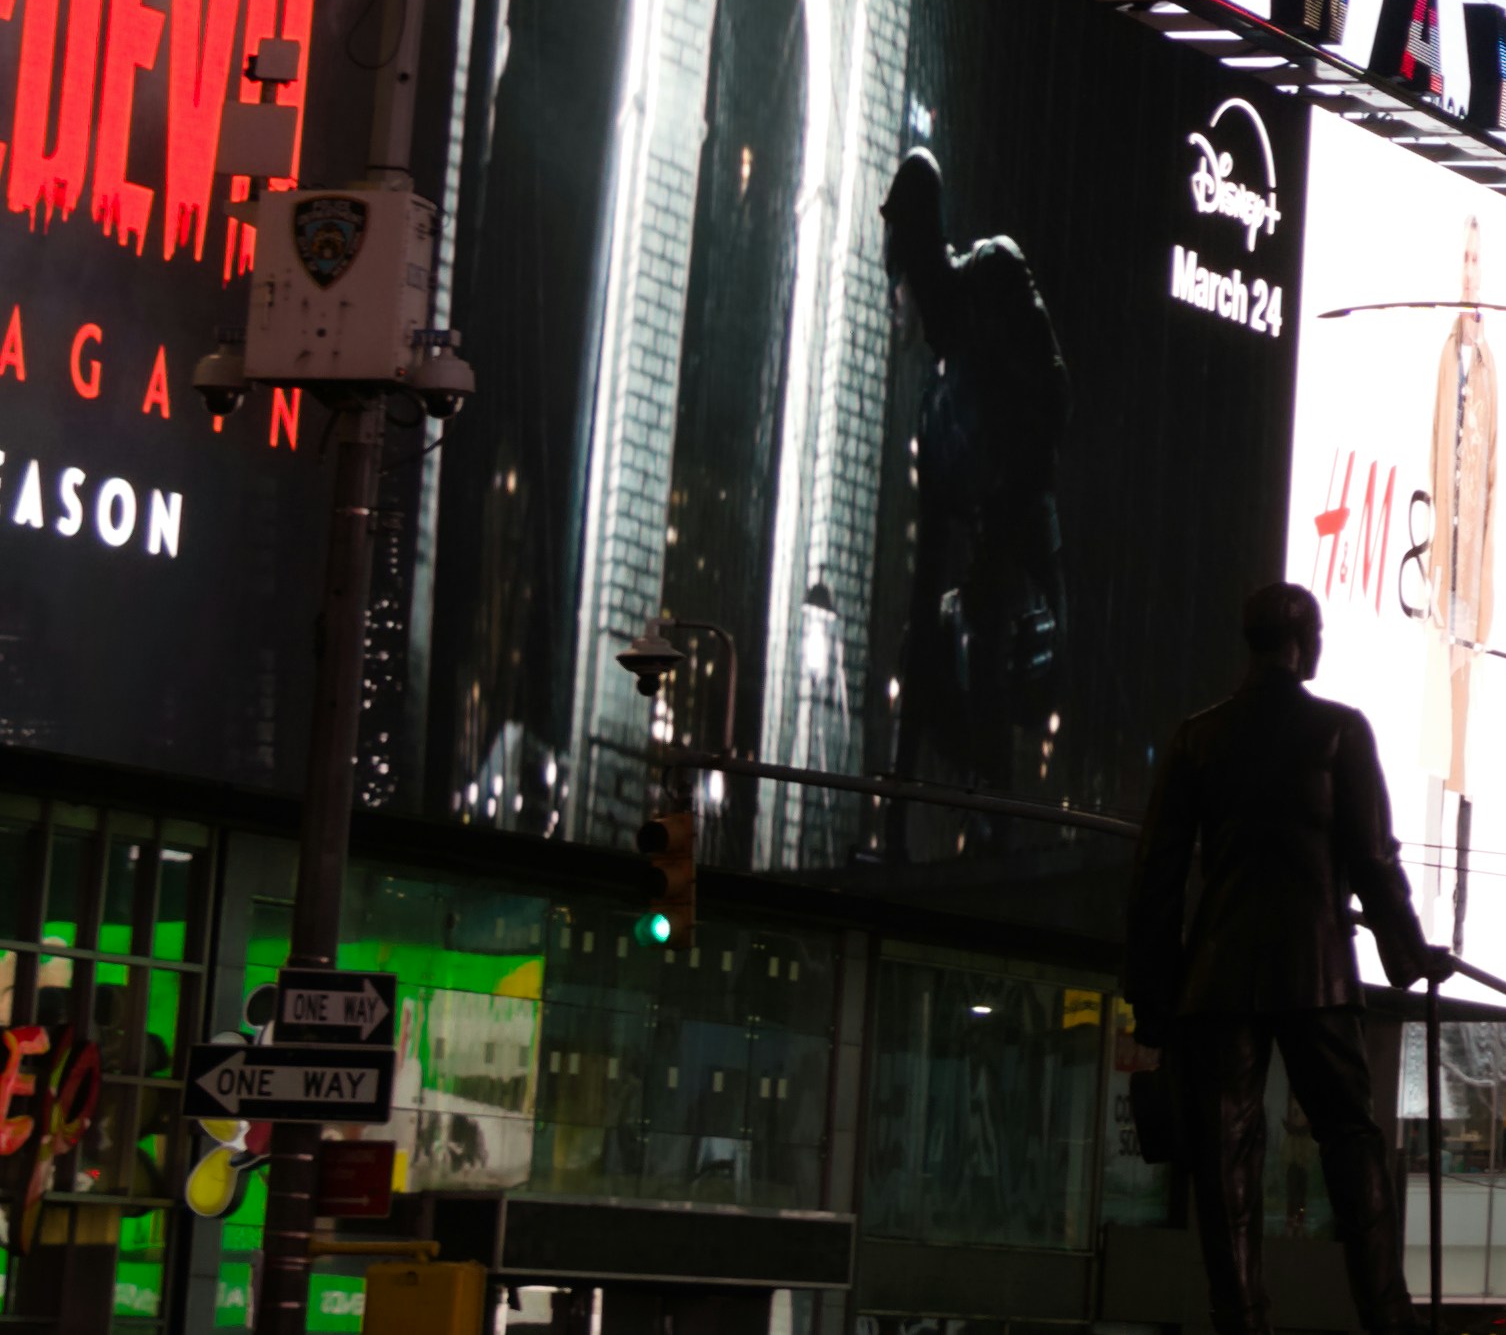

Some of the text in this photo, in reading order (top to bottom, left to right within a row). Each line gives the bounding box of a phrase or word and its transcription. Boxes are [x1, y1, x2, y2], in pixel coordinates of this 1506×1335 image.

[1171, 243, 1283, 338] March 24
[0, 303, 303, 452] AGAN
[0, 451, 184, 559] ASON
[293, 993, 380, 1024] ONE WAY
[216, 1068, 367, 1100] ONE WAY
